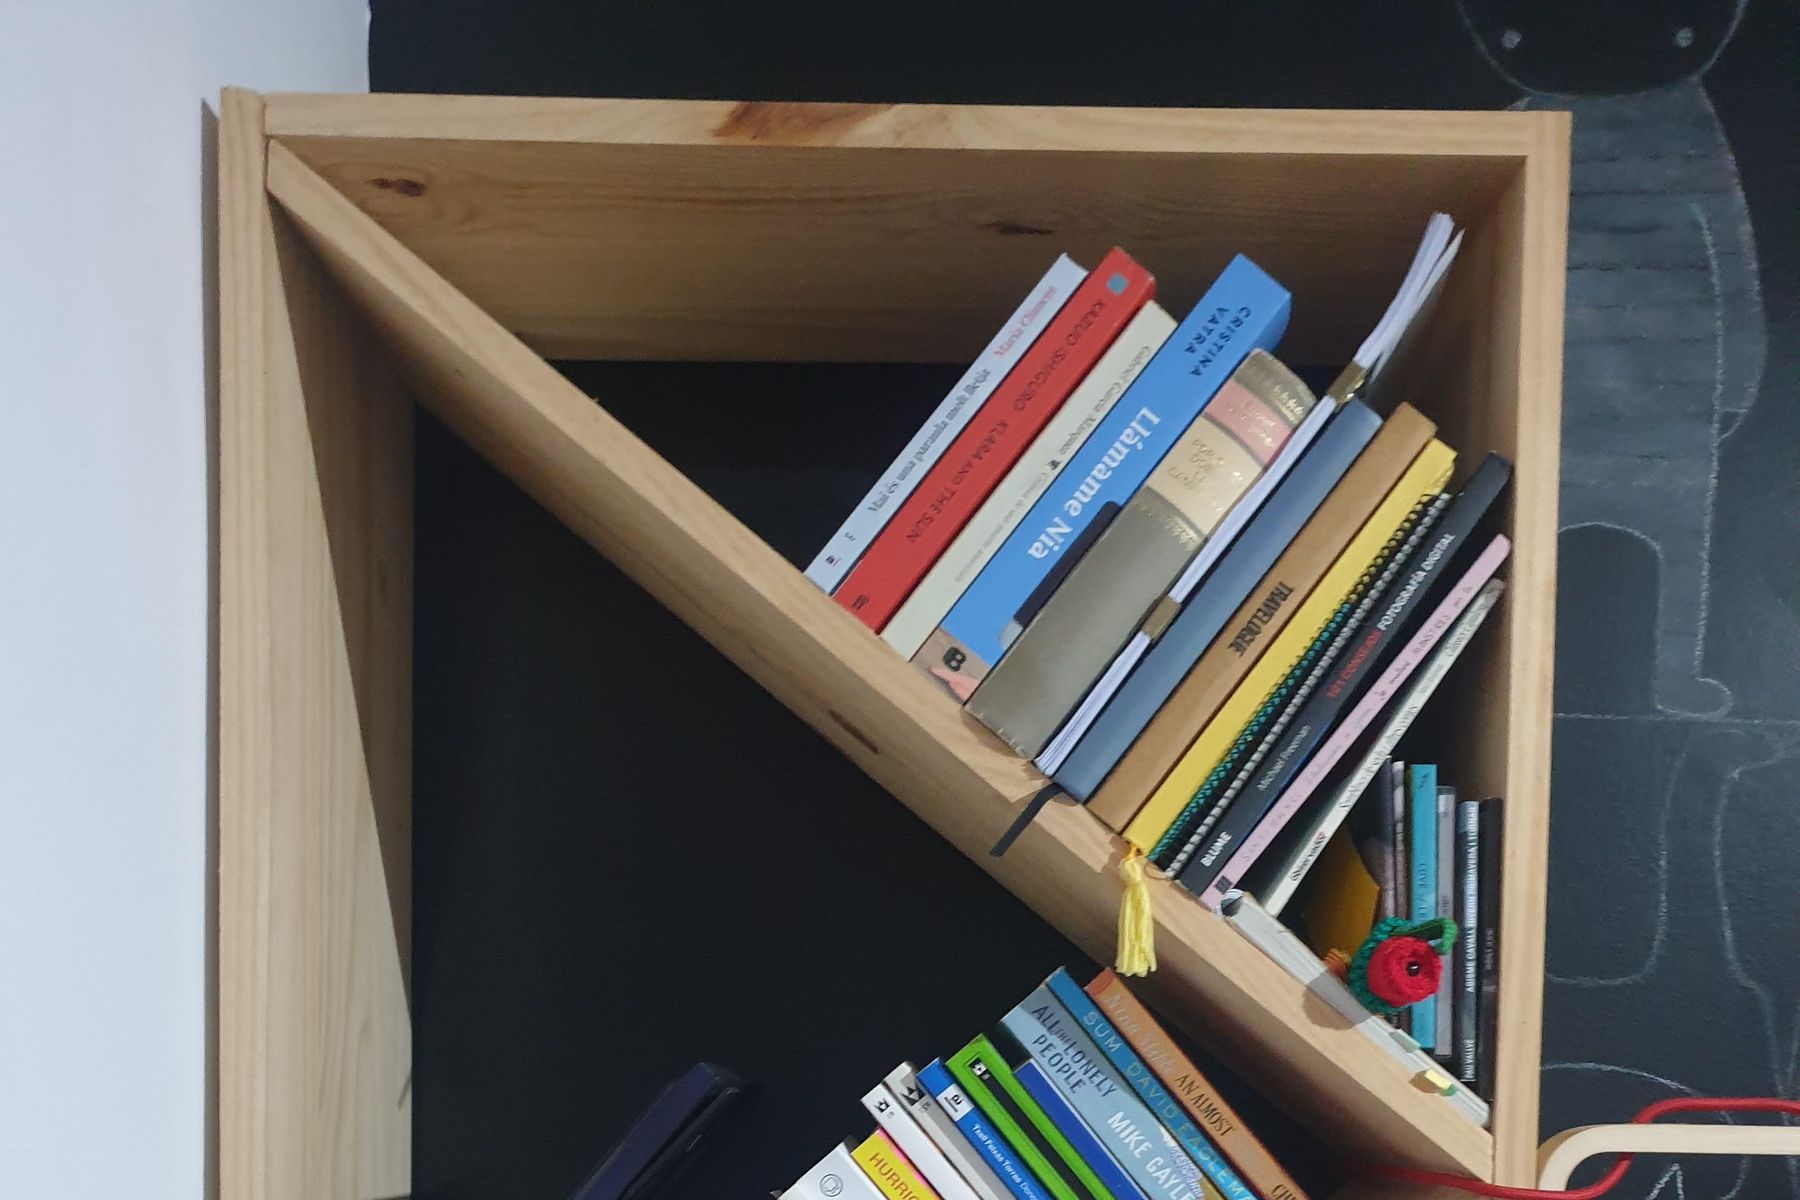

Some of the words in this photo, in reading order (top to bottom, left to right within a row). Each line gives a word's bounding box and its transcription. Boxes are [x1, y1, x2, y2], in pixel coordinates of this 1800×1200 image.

[1182, 302, 1229, 357] VATRA
[1188, 303, 1252, 379] CRISTINA
[1058, 405, 1164, 522] Llámame
[1025, 514, 1074, 567] Nia
[1199, 829, 1233, 868] BLUME
[1029, 1032, 1088, 1095] PEOPLE
[1030, 1001, 1060, 1033] ALL
[1062, 1039, 1118, 1100] LONELY
[1080, 1009, 1122, 1054] SUM
[1123, 1060, 1180, 1121] DAVID
[1104, 1109, 1154, 1160] MIKE
[1172, 1071, 1197, 1096] AN
[1189, 1090, 1235, 1139] ALMOST
